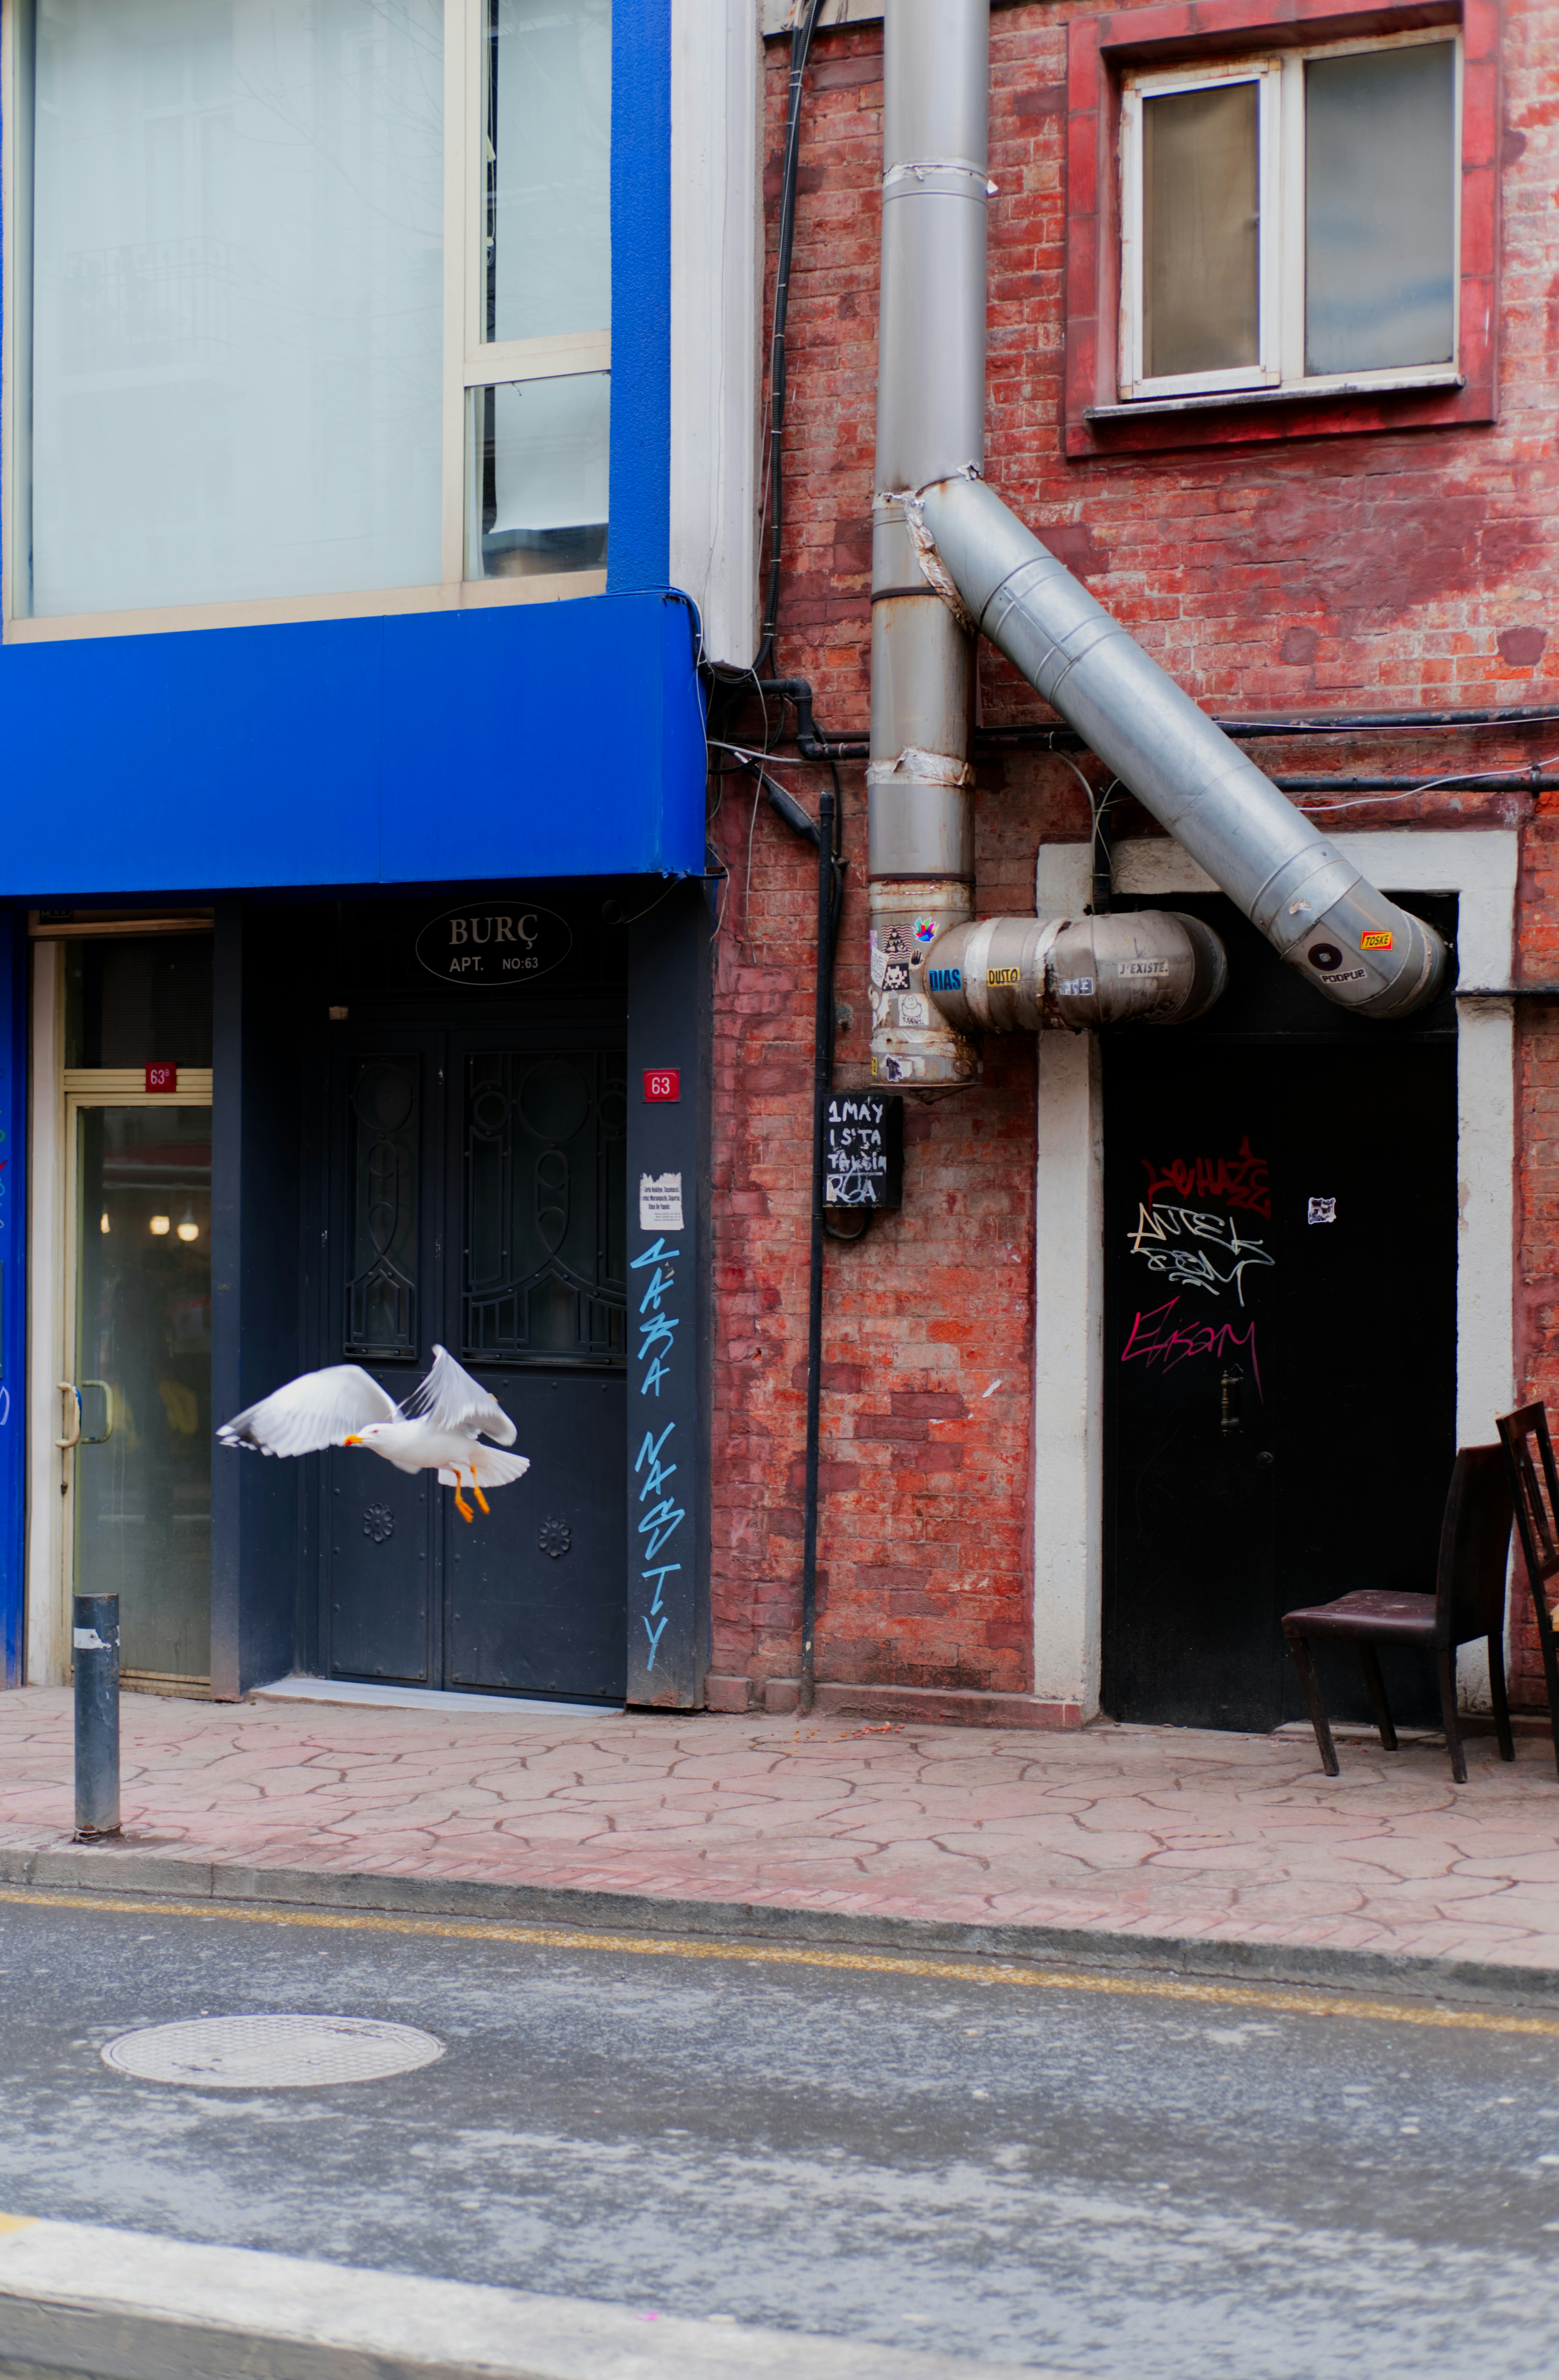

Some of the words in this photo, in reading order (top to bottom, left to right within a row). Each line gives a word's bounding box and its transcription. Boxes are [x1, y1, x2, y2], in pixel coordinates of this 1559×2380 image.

[449, 914, 538, 949] BURÇ
[1365, 935, 1389, 947] TOSKE
[449, 956, 484, 972] APT.
[503, 957, 538, 970] NO:63
[929, 969, 962, 991] DIAS
[652, 1077, 670, 1094] 63
